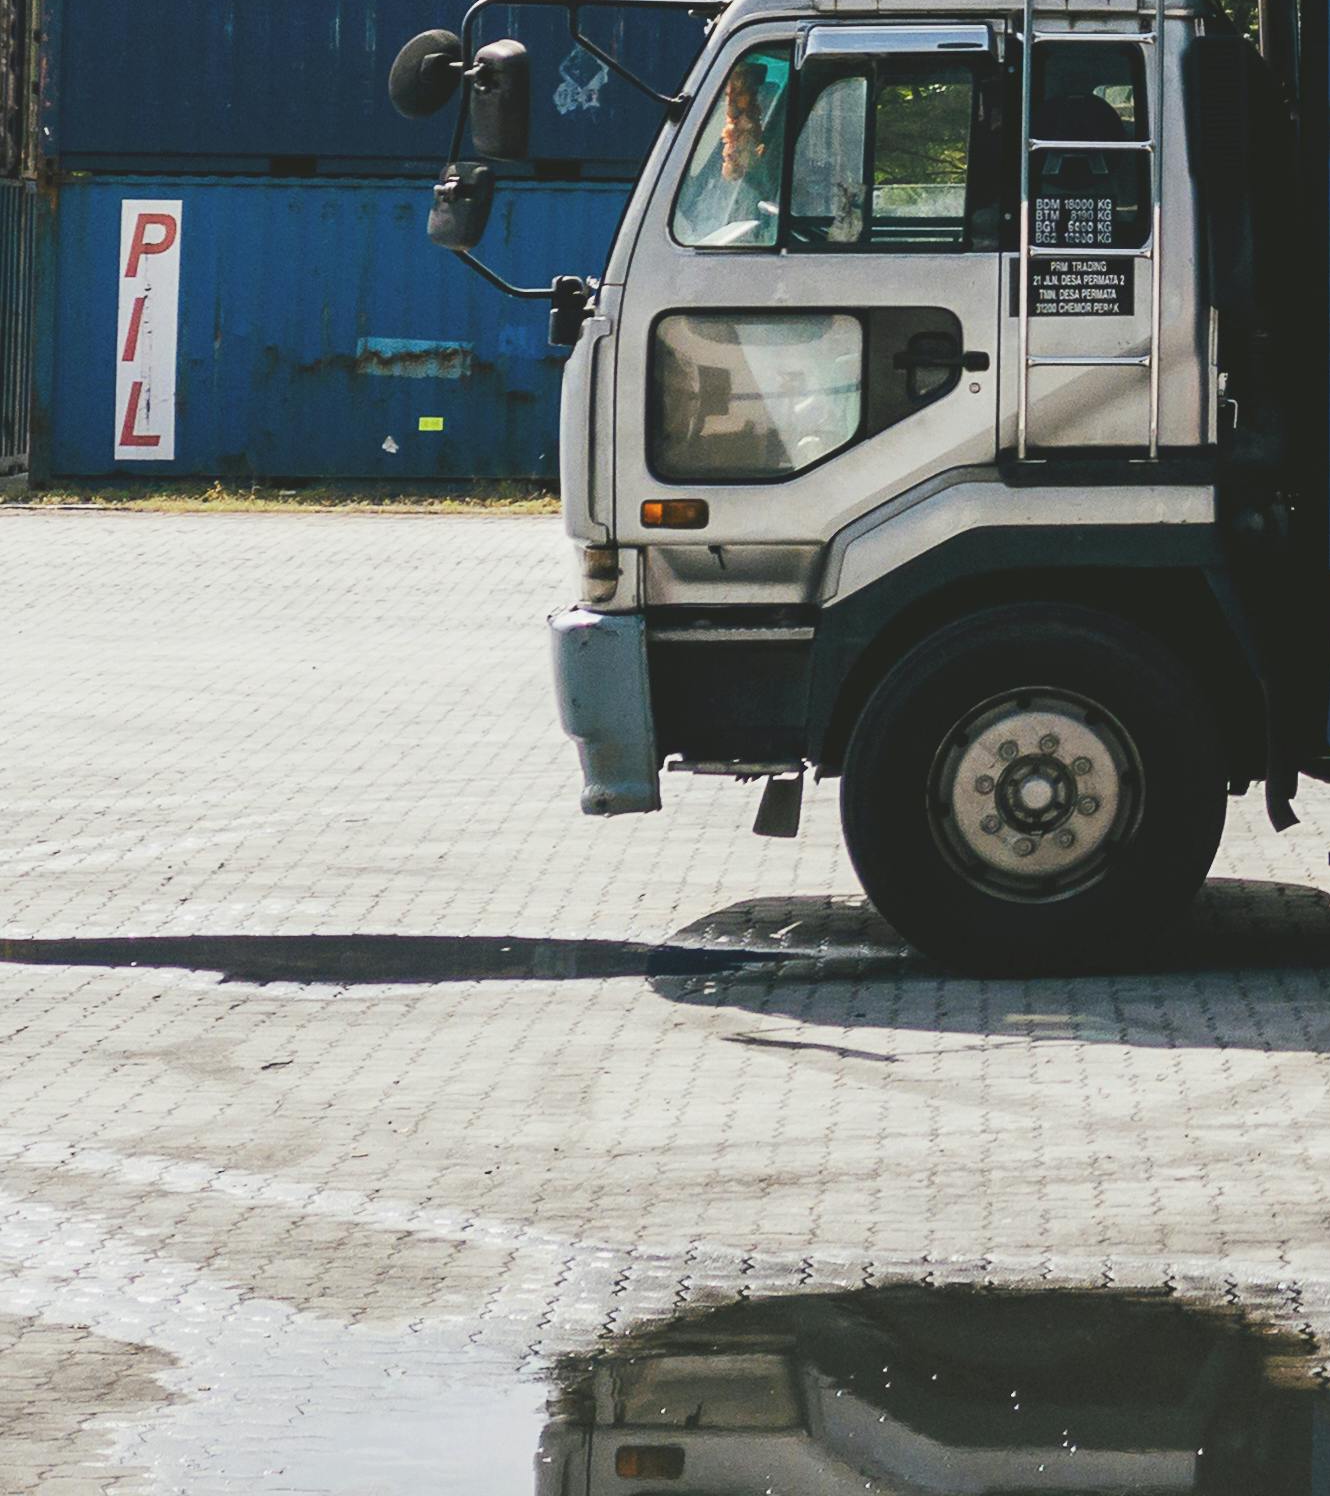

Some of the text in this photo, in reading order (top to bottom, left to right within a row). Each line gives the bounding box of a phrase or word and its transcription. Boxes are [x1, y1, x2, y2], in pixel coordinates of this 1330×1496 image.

[1036, 198, 1112, 210] BDM 18000 KG
[1035, 210, 1060, 221] BTM
[1097, 210, 1112, 221] KG
[1035, 221, 1056, 232] BG1
[1097, 221, 1112, 232] KG
[1035, 233, 1057, 244] BG2
[1097, 233, 1112, 244] KG
[1071, 261, 1107, 272] TRADING
[1033, 275, 1042, 286] 21
[1061, 274, 1082, 286] DESA
[1083, 274, 1119, 286] PERMATA
[1119, 275, 1126, 286] 2
[1059, 289, 1080, 300] DESA
[1081, 288, 1117, 300] PERMATA
[1058, 302, 1092, 313] CHEMOR
[119, 213, 178, 446] PIL
